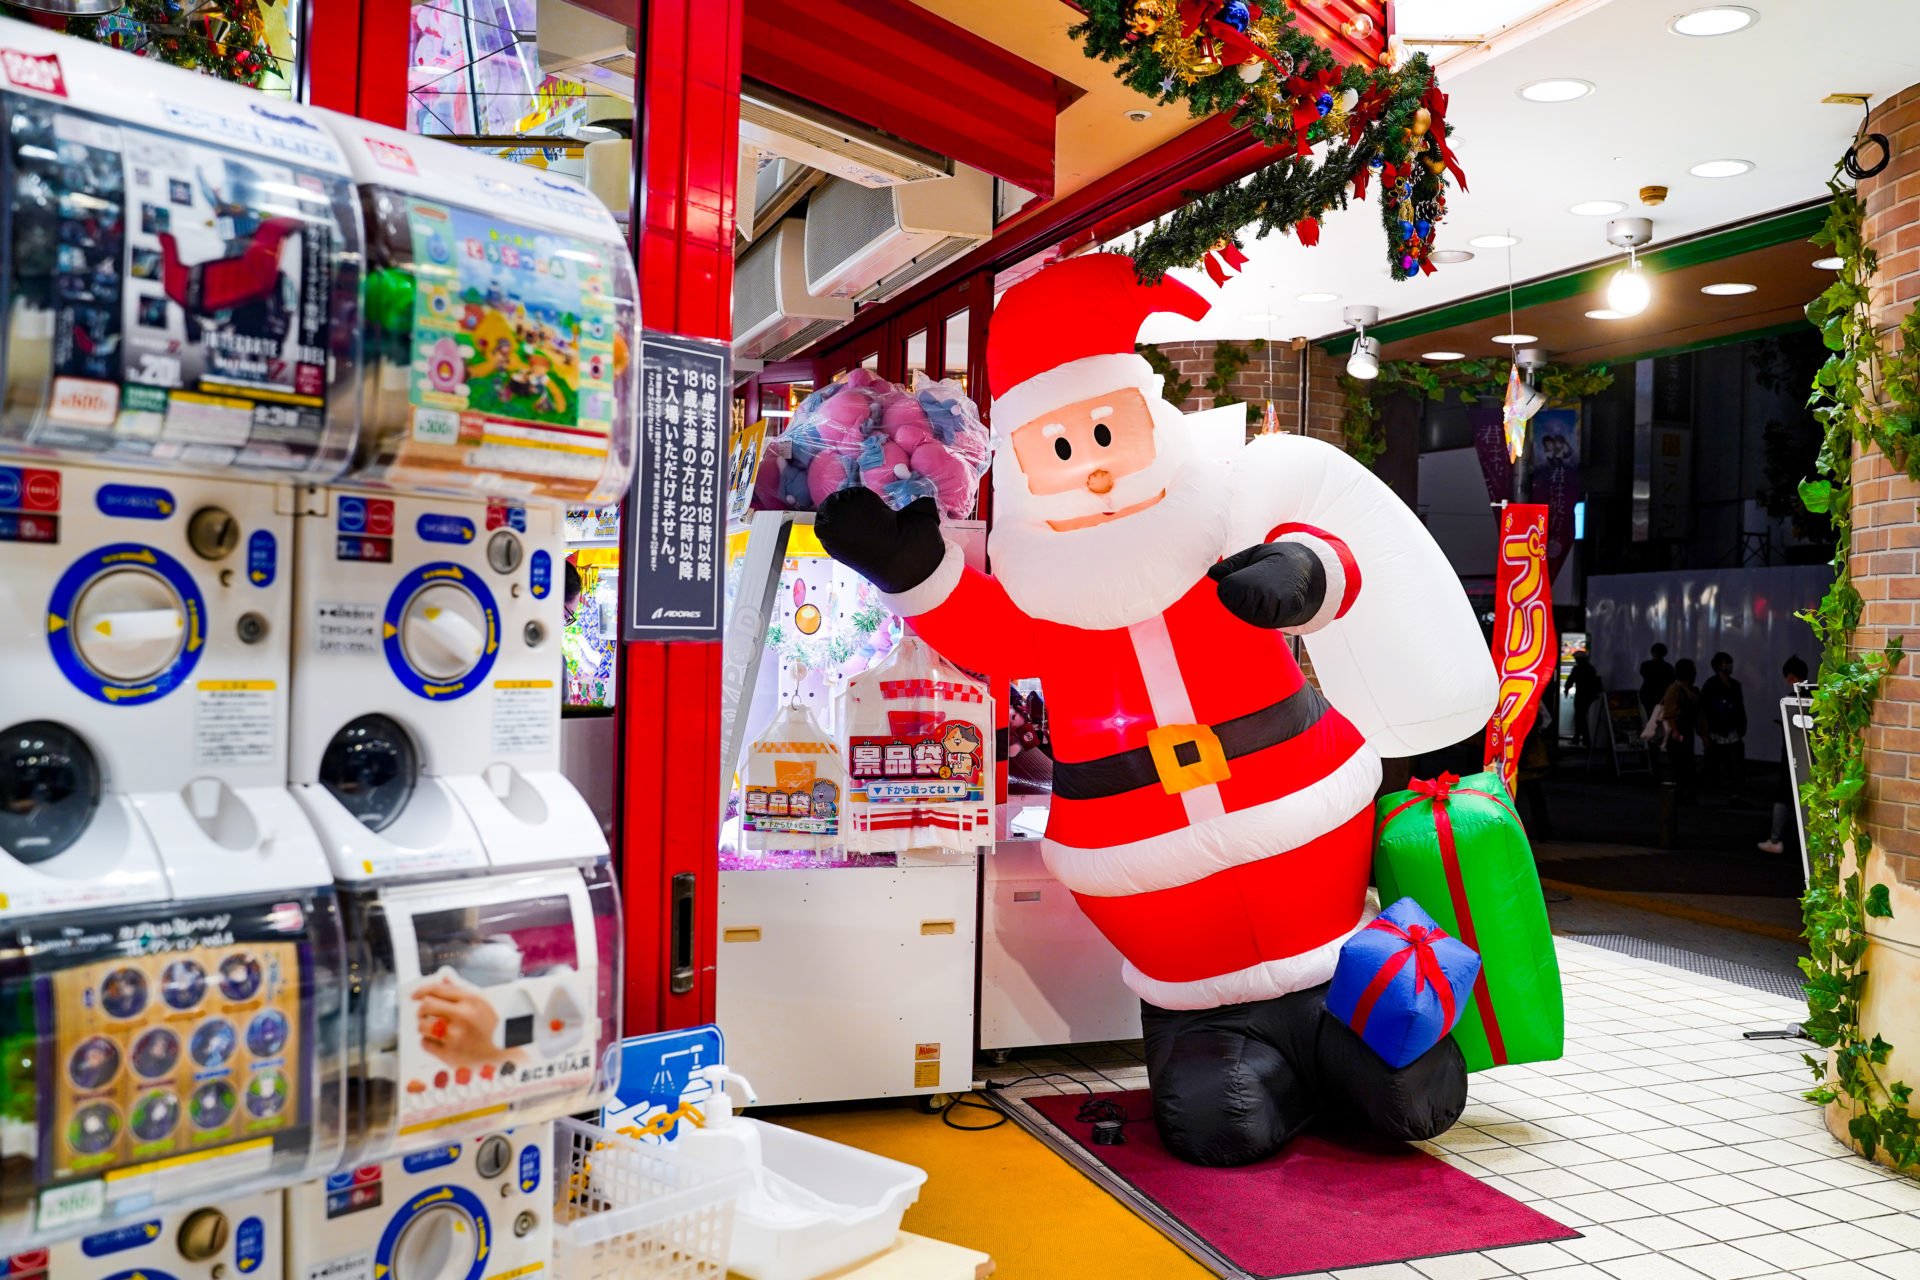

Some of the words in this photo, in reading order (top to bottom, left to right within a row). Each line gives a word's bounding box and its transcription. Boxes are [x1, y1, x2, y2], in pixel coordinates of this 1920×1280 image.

[660, 366, 680, 566] ご入場いただけません。
[678, 368, 699, 581] 18歳未満の方は22時以降
[696, 372, 716, 582] 16歳未満の方は18時以降
[747, 792, 811, 816] 景品袋
[853, 744, 943, 777] 景品袋
